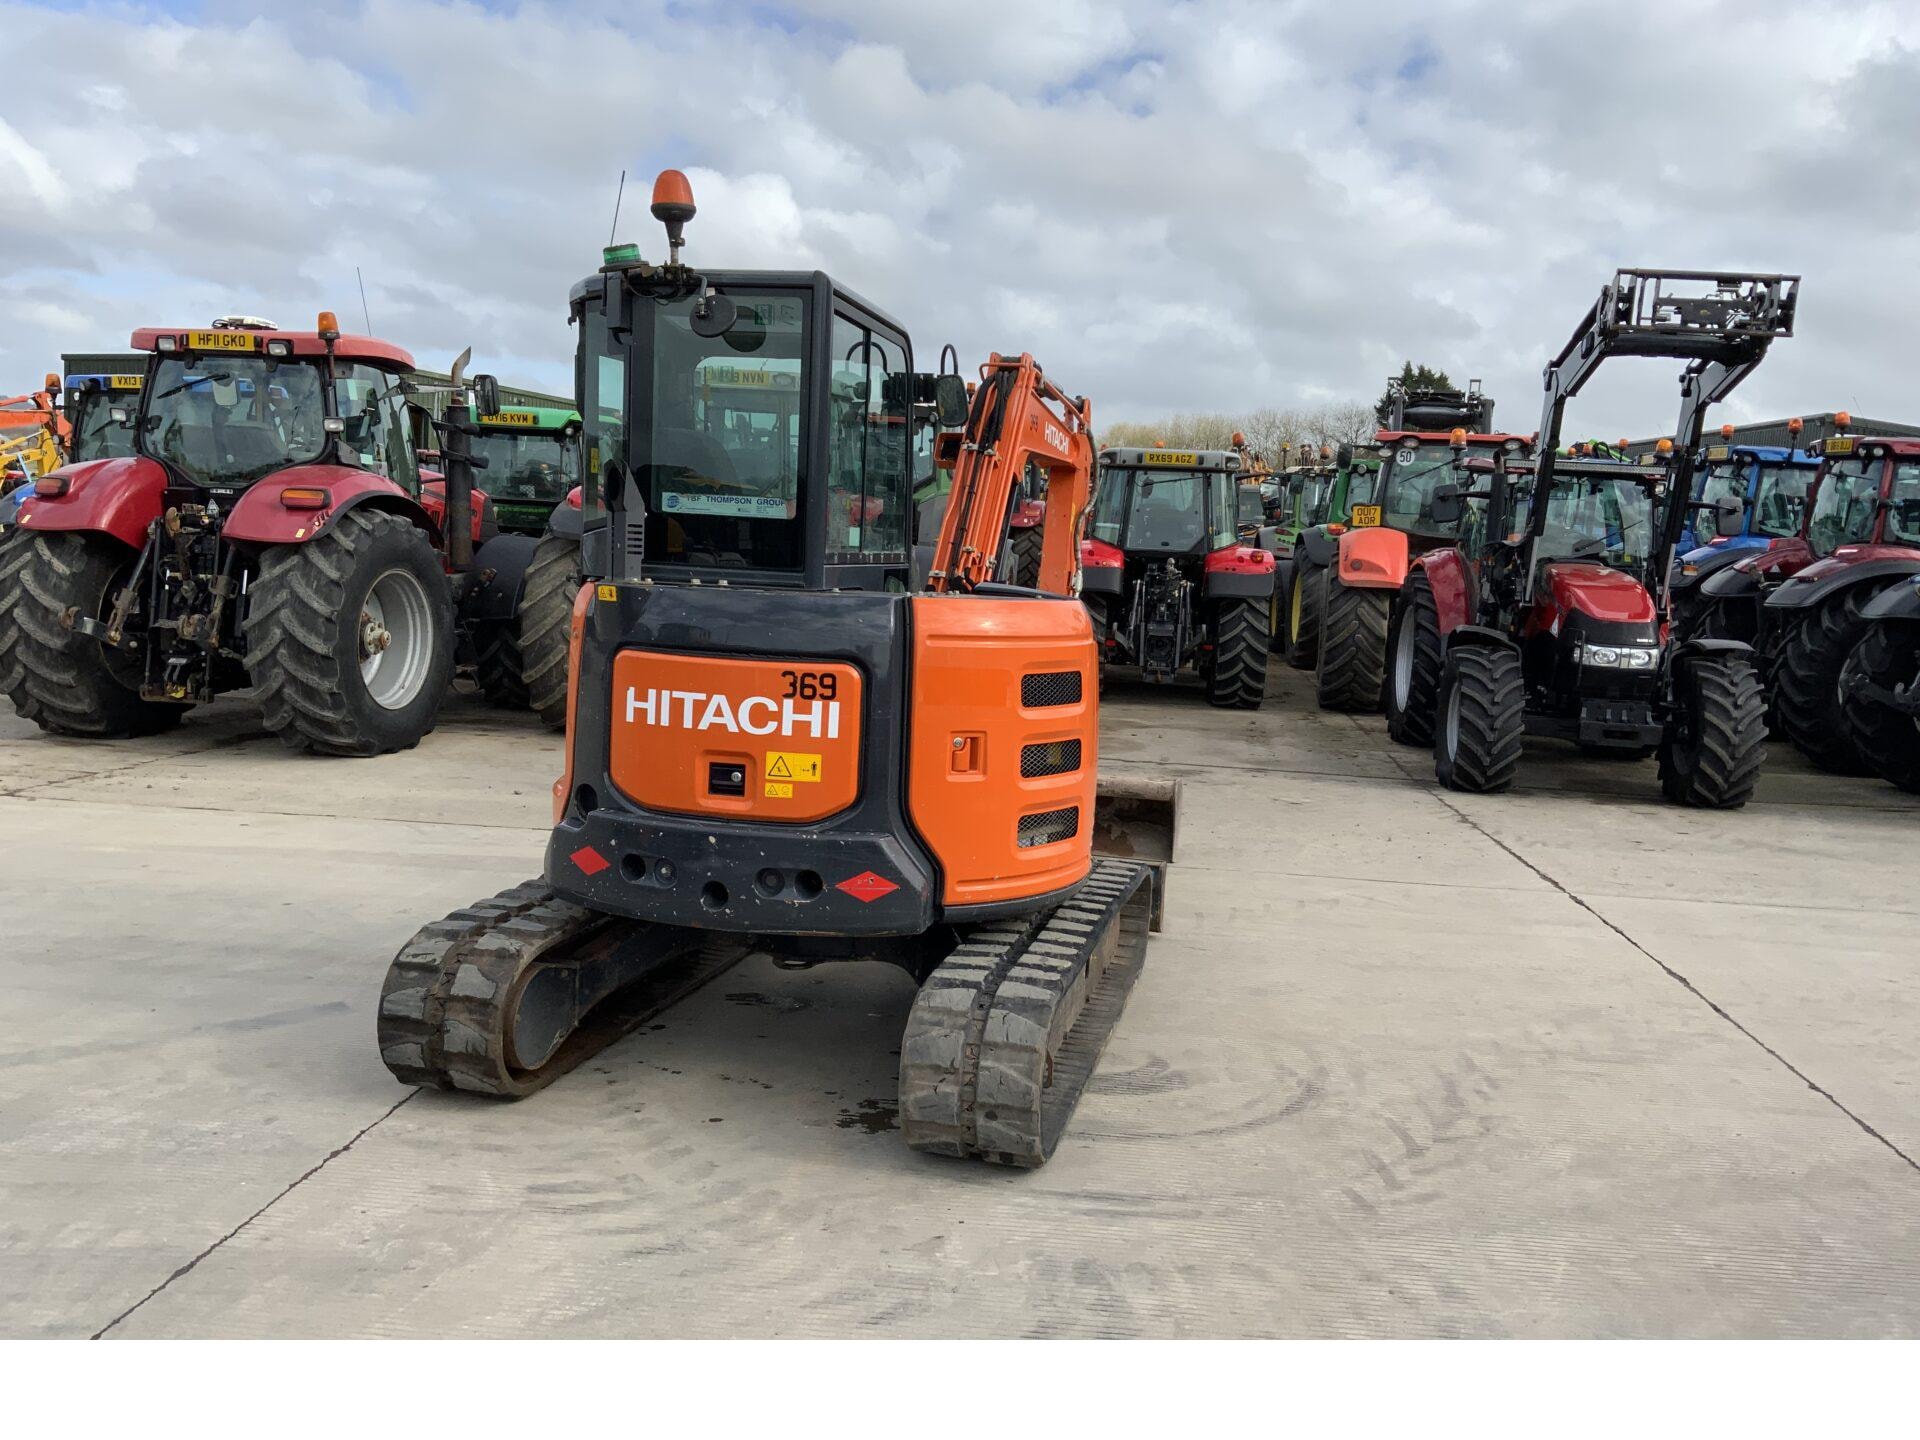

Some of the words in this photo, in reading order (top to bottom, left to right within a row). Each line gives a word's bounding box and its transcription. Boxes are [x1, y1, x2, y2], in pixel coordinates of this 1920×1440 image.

[198, 333, 220, 346] HF11
[222, 334, 246, 347] GKO
[117, 376, 137, 386] VX13
[1044, 421, 1069, 456] HITACHI
[1149, 453, 1173, 463] RX69
[1399, 450, 1412, 463] 50
[706, 495, 752, 505] THOMPSON
[781, 670, 837, 701] 369
[625, 686, 840, 739] HITACHI
